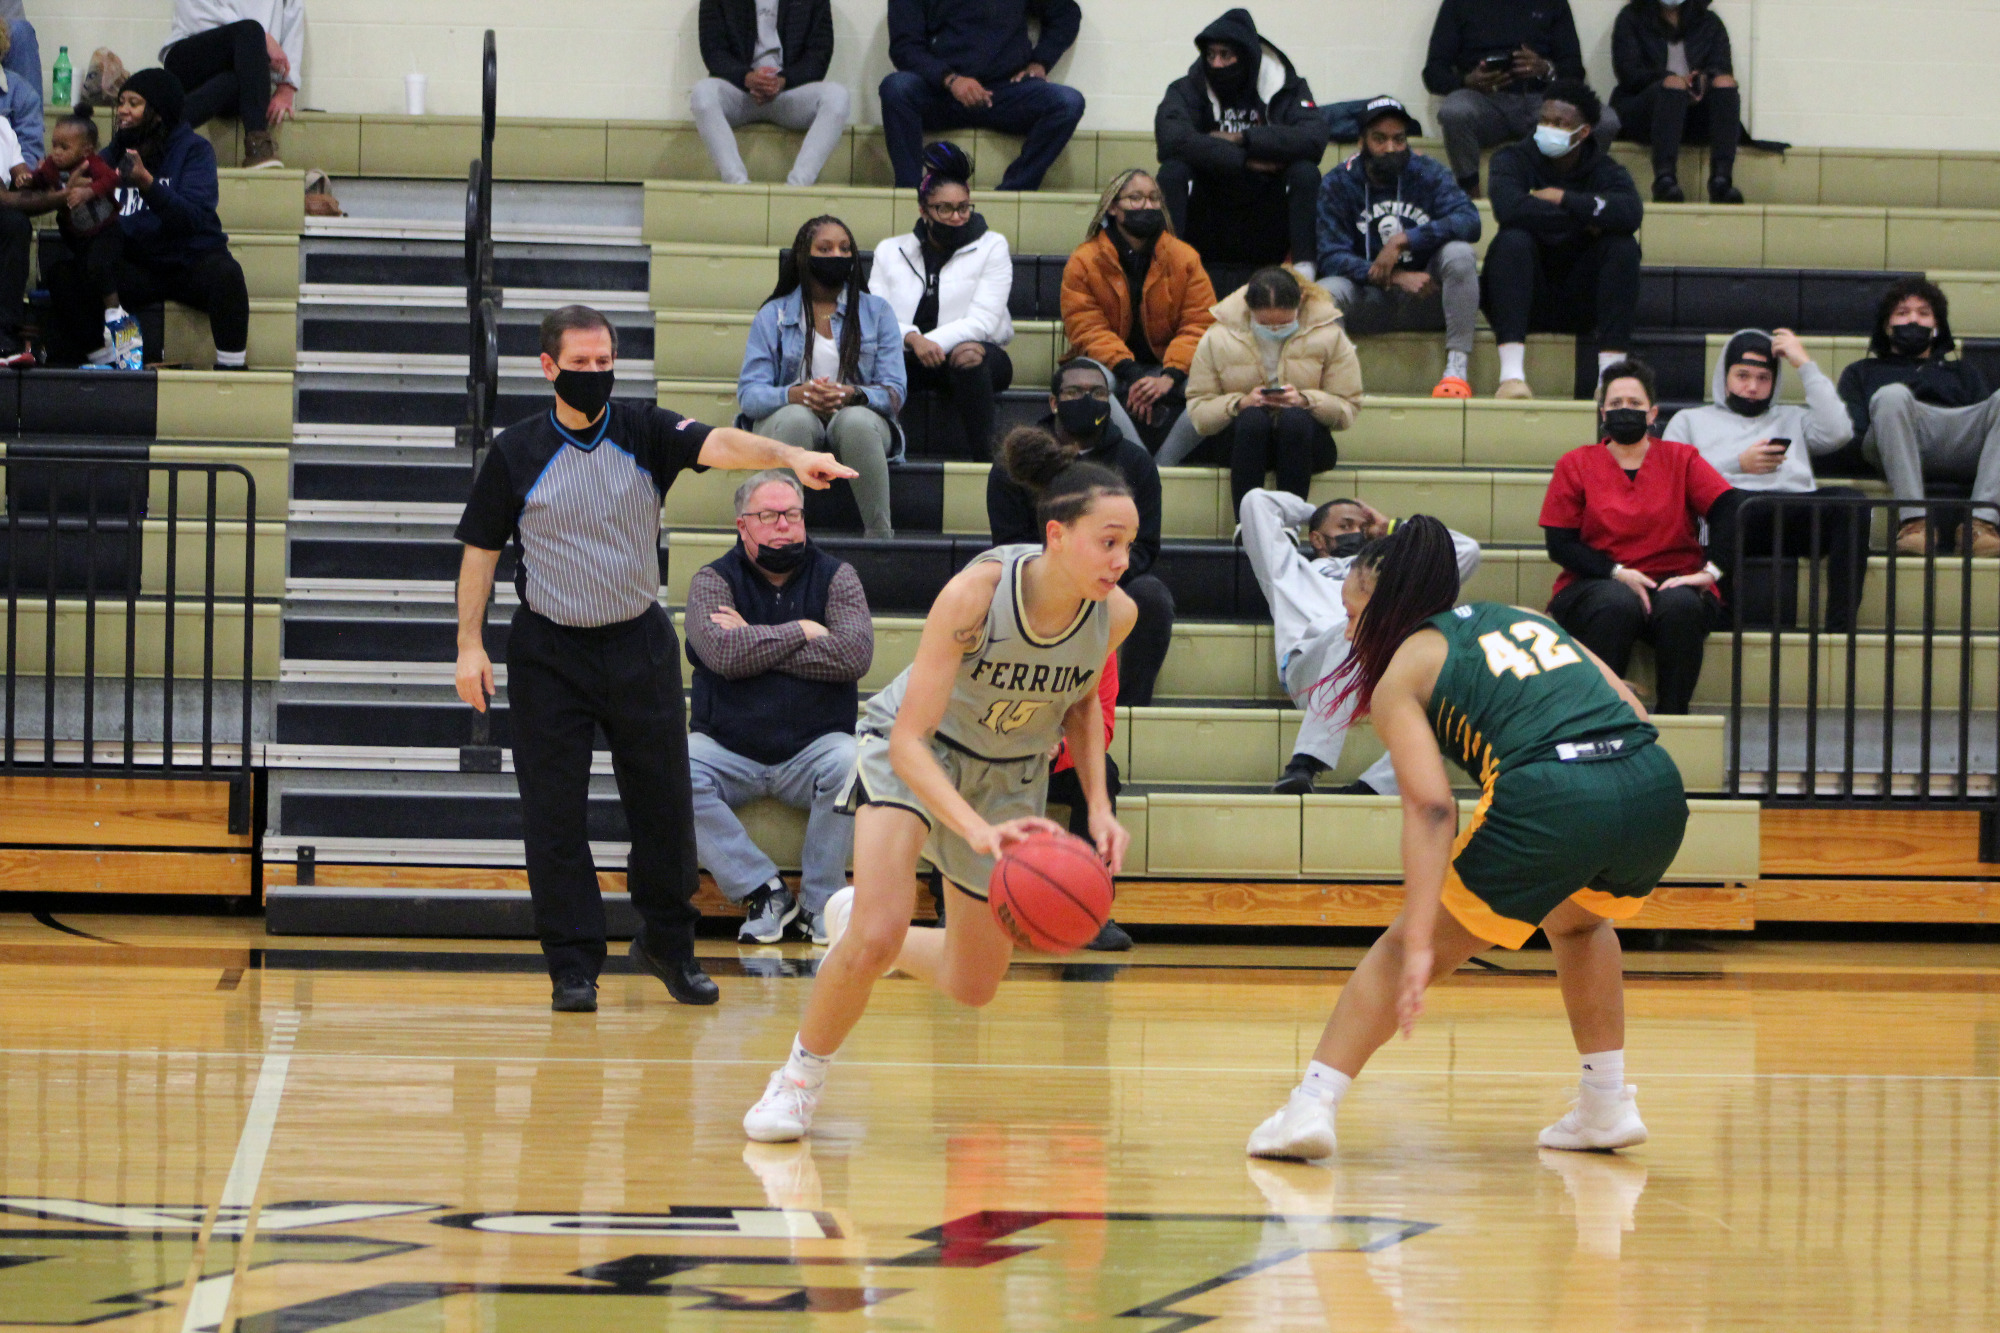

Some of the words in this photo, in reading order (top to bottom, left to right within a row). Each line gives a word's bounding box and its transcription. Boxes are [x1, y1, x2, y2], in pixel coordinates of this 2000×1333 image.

[1478, 620, 1583, 681] 42
[970, 658, 1095, 694] FERRUM
[977, 699, 1054, 735] 15
